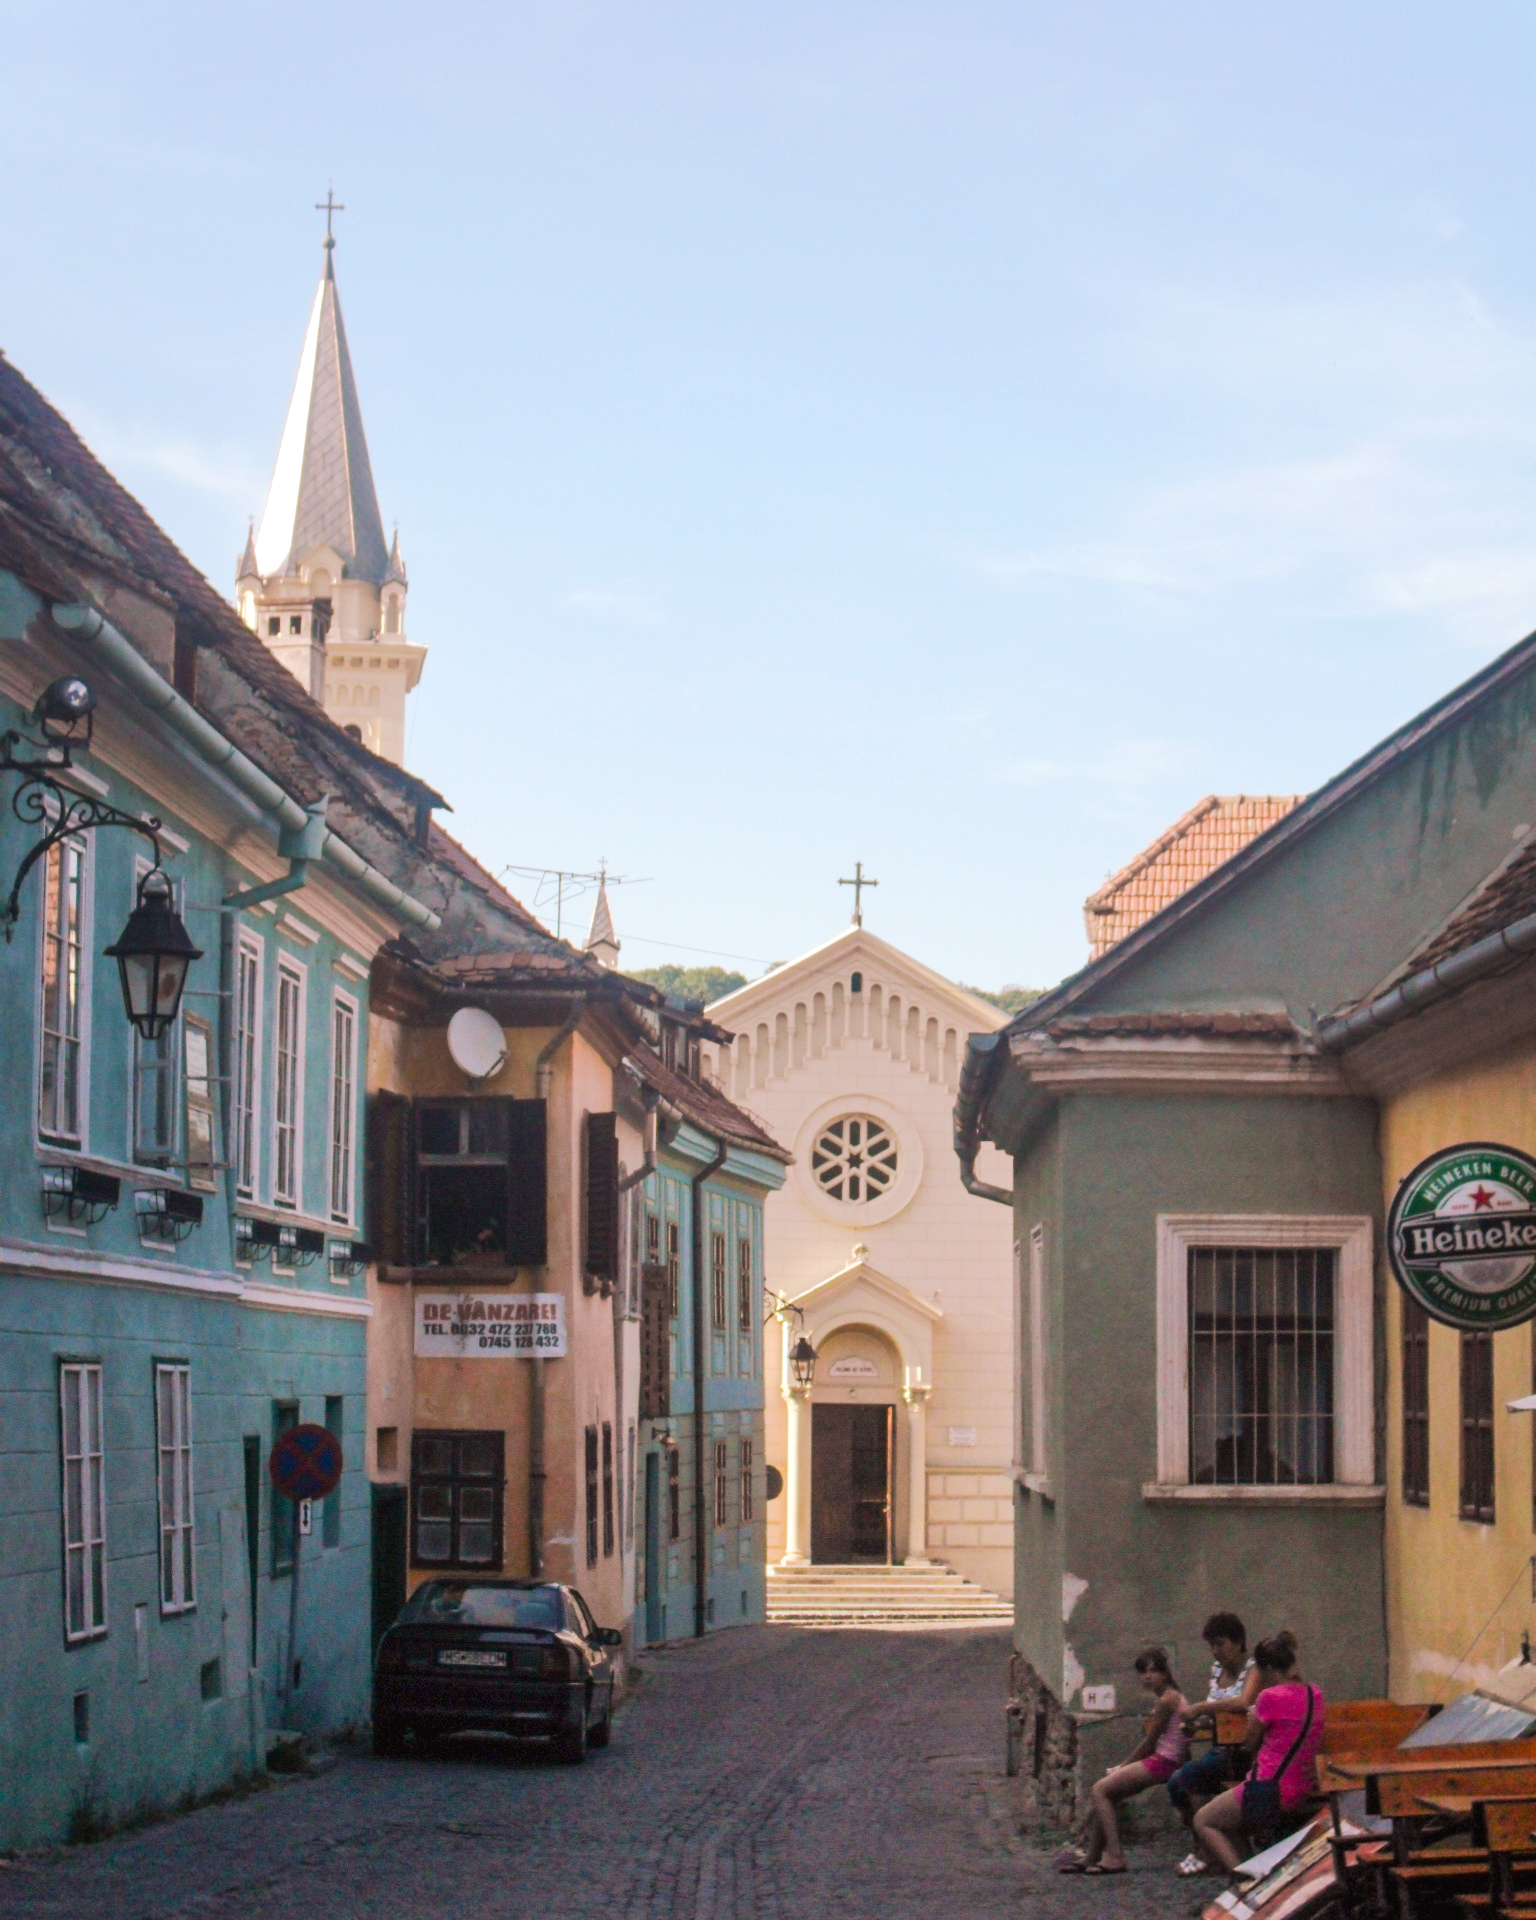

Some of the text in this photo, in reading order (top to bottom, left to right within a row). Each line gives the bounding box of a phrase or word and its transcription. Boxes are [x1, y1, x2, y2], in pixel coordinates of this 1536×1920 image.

[1423, 1162, 1534, 1202] HEINEKEN BEER
[1413, 1221, 1536, 1254] Heineke
[1428, 1275, 1491, 1311] PREMIUM
[423, 1303, 451, 1320] DE
[424, 1324, 448, 1335] TEL.
[478, 1336, 511, 1348] 0745
[535, 1336, 559, 1348] 432
